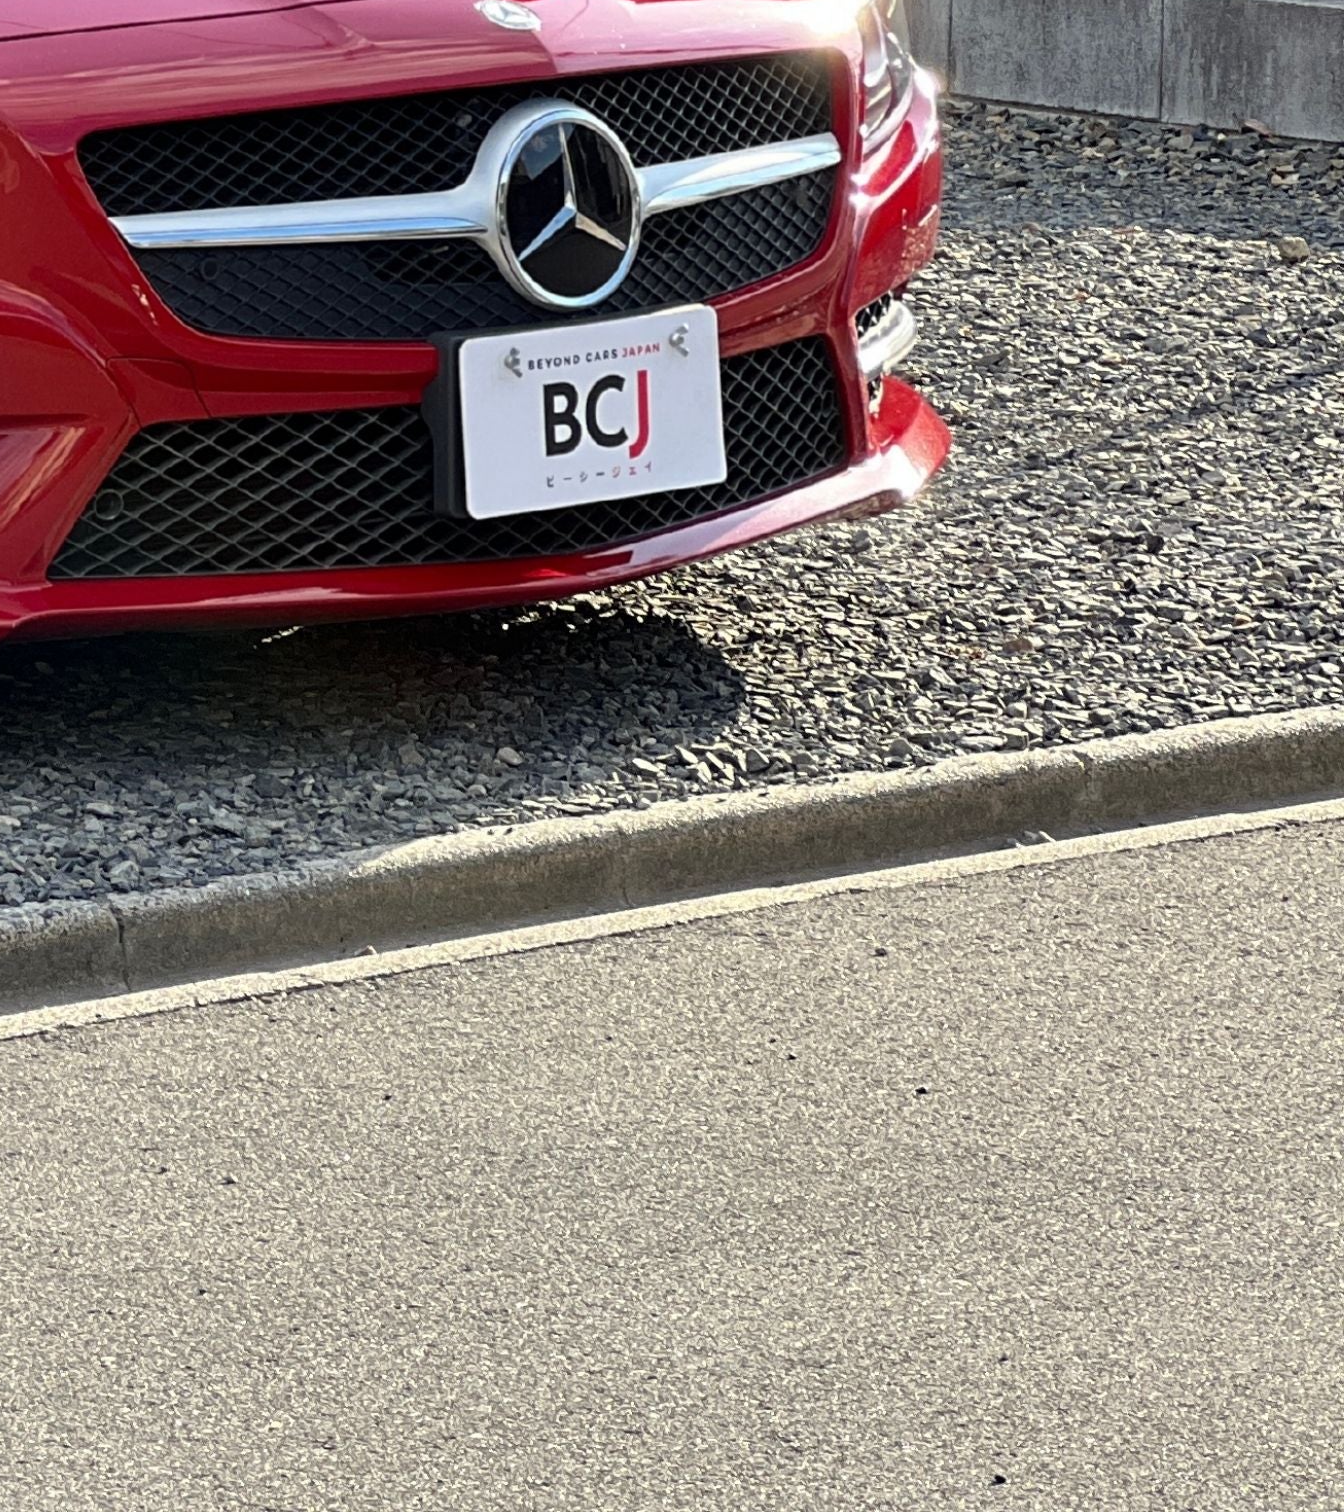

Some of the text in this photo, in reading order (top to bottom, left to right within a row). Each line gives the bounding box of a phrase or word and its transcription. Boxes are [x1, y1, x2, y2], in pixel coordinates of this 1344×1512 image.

[527, 342, 661, 370] BEYOND CARS JAPAN
[543, 369, 650, 459] BCJ
